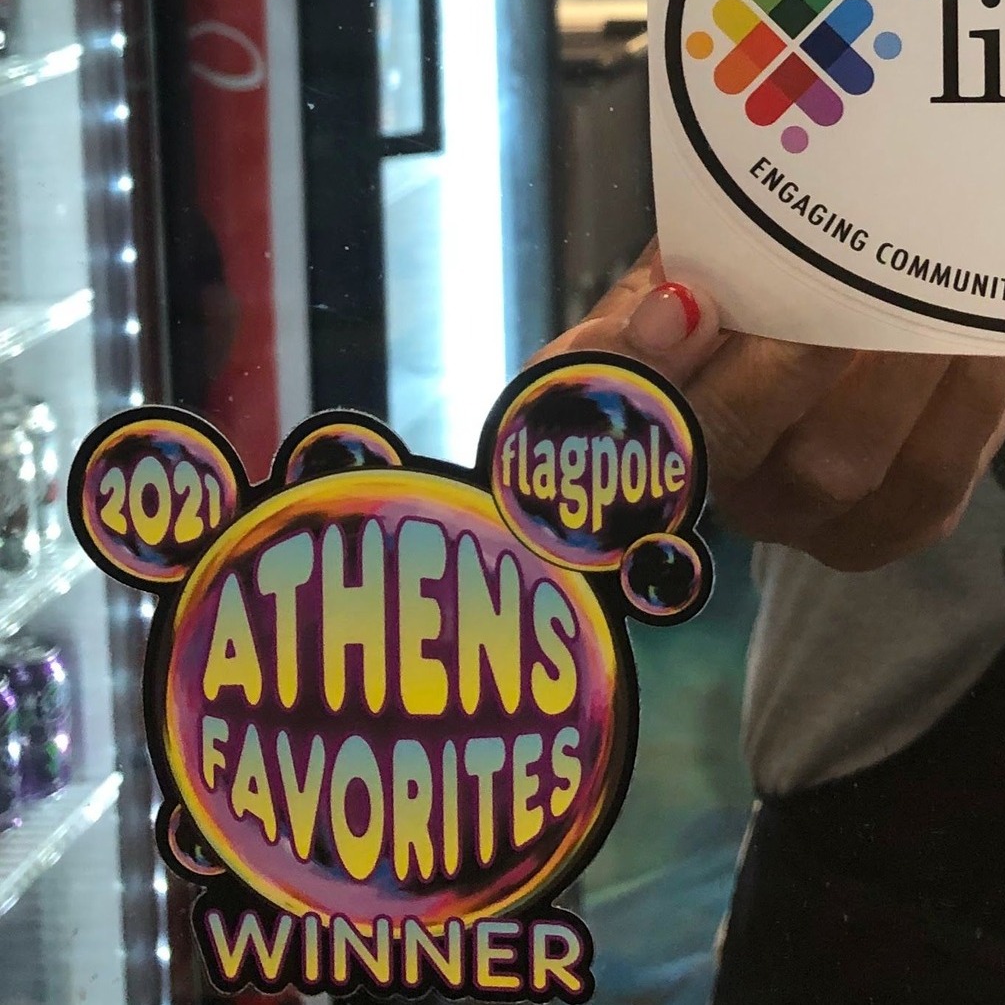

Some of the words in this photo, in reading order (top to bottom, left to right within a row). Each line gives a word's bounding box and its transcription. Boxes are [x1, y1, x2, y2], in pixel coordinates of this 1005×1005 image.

[749, 156, 869, 252] ENGAGING
[99, 456, 222, 546] 2021
[501, 425, 686, 531] flagpole
[203, 518, 578, 717] ATHENS
[203, 716, 583, 881] FAVORITES
[207, 910, 584, 991] WINNER
